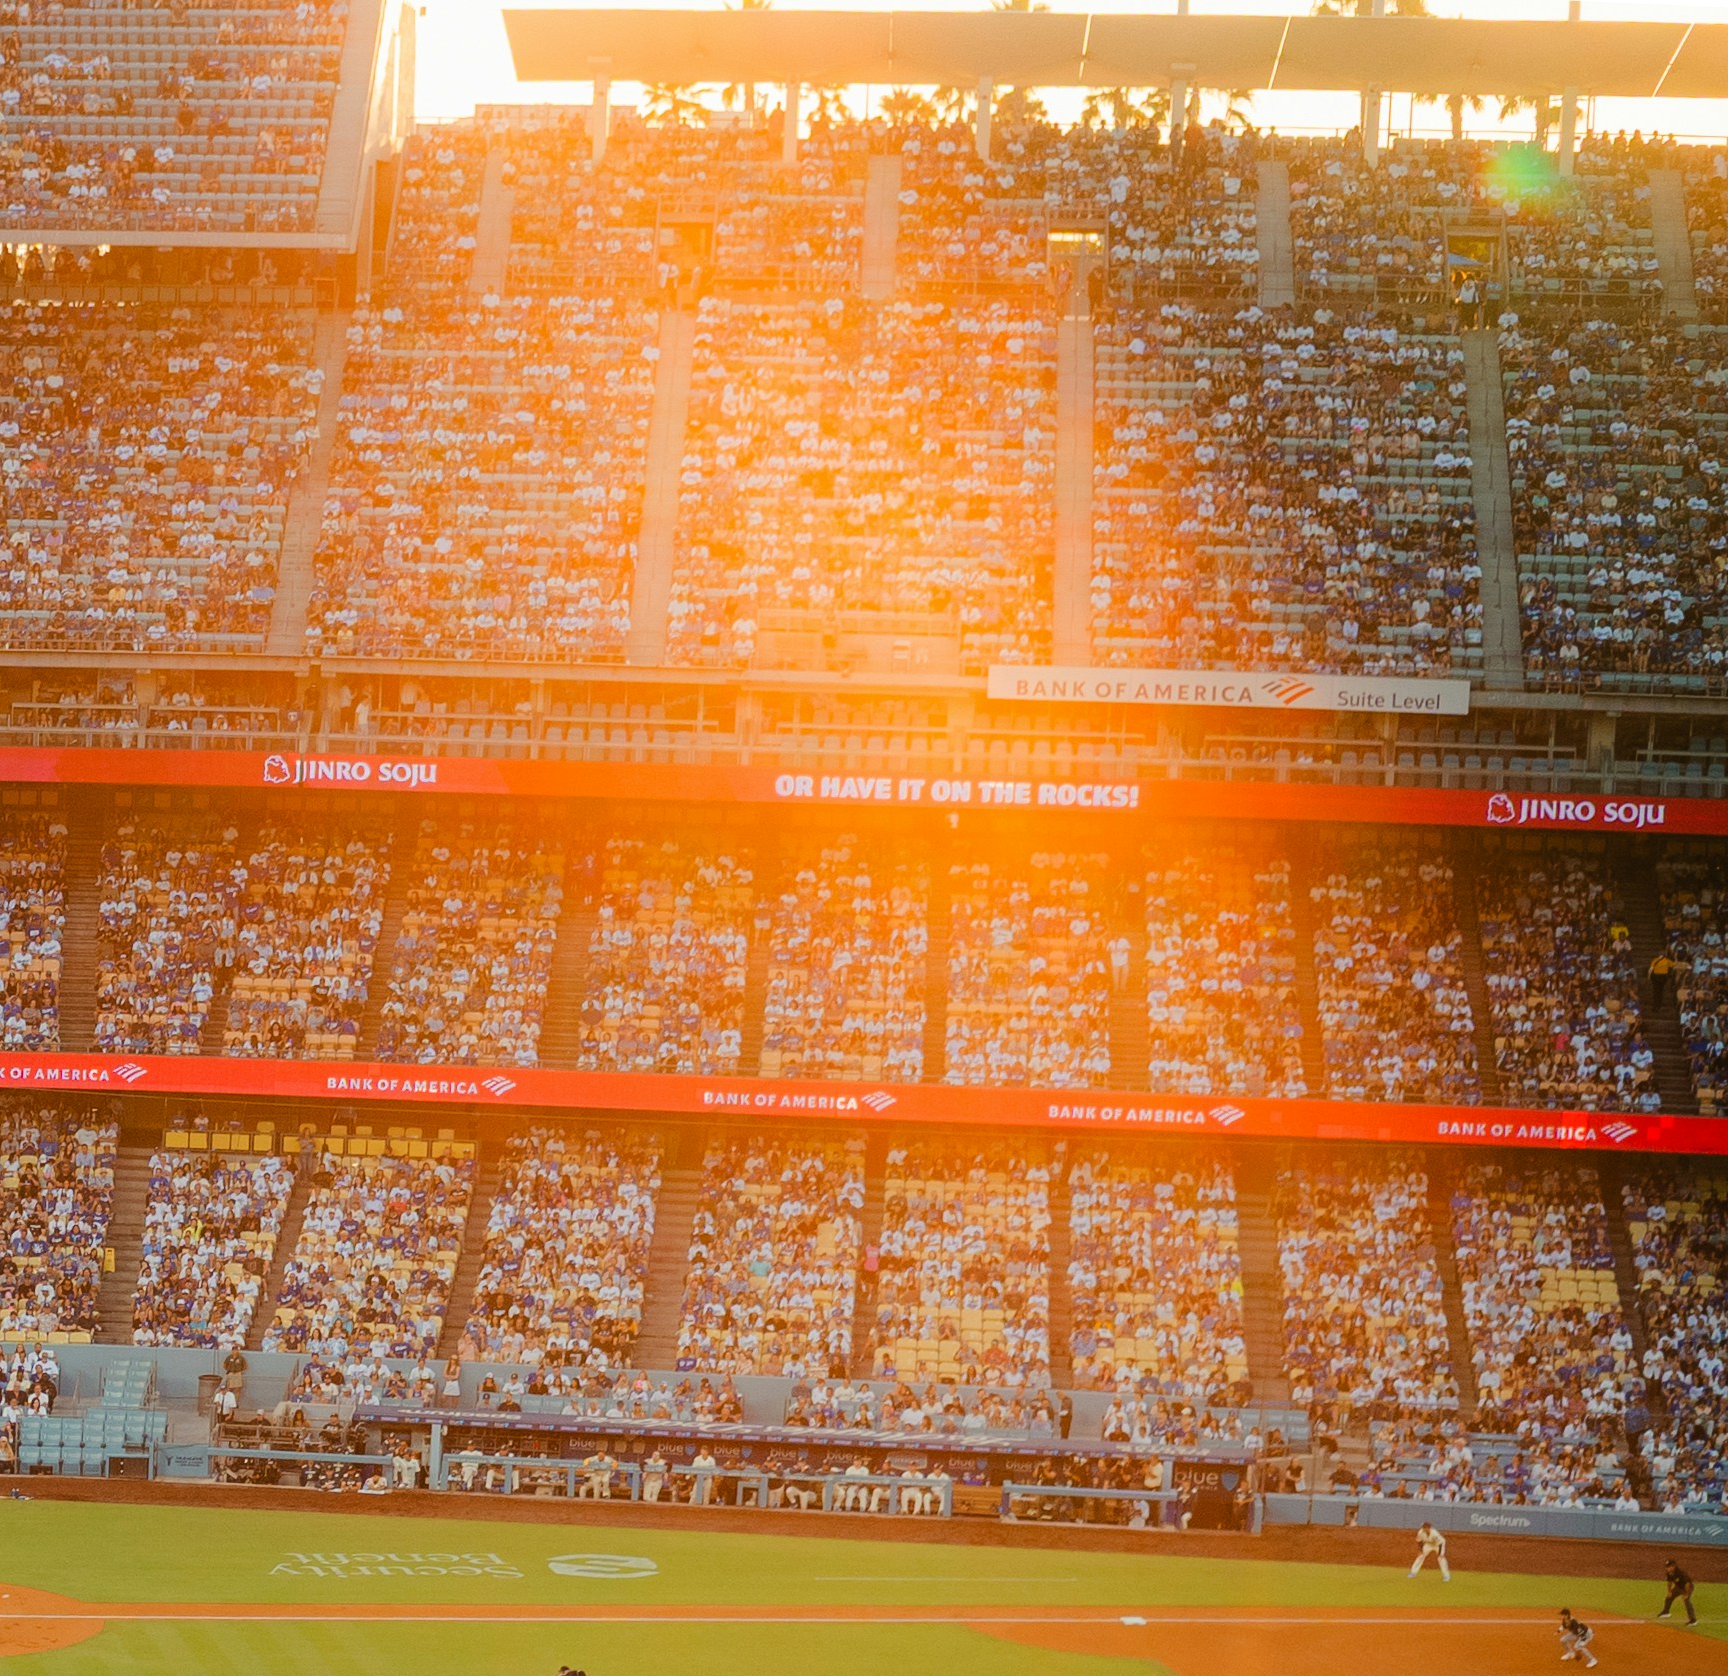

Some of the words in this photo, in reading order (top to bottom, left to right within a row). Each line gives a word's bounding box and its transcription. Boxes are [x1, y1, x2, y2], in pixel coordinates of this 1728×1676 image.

[1017, 680, 1085, 698] BANK
[1095, 682, 1127, 698] OF
[1135, 684, 1253, 702] AMERICA
[1338, 691, 1384, 708] Suite
[1392, 693, 1440, 709] Level
[292, 760, 370, 783] JINRO
[379, 762, 436, 787] SOJU
[775, 775, 813, 797] OR
[820, 776, 891, 799] HAVE
[898, 779, 925, 800] IT
[931, 780, 971, 802] ON
[977, 782, 1031, 803] THE
[1037, 783, 1138, 807] ROCKS!
[1518, 799, 1595, 824] JINRO
[1604, 803, 1665, 828] SOJU
[10, 1067, 31, 1078] OF
[34, 1068, 109, 1081] AMERICA
[327, 1077, 372, 1090] BANK
[377, 1079, 398, 1090] OF
[401, 1080, 477, 1094] AMERICA
[704, 1091, 749, 1105] BANK
[754, 1094, 776, 1106] OF
[780, 1095, 857, 1110] AMERICA
[1048, 1105, 1097, 1119] BANK
[1100, 1107, 1123, 1119] OF
[1126, 1109, 1205, 1124] AMERICA
[1438, 1121, 1485, 1136] BANK
[1490, 1123, 1513, 1136] OF
[1516, 1125, 1596, 1140] AMERICA
[1174, 1469, 1219, 1484] blue
[1469, 1513, 1528, 1528] Spectrum
[1611, 1524, 1639, 1533] BANK
[1640, 1525, 1653, 1533] OF
[1655, 1526, 1702, 1536] AMERICA
[284, 1552, 505, 1565] Benefit
[268, 1564, 525, 1580] Security
